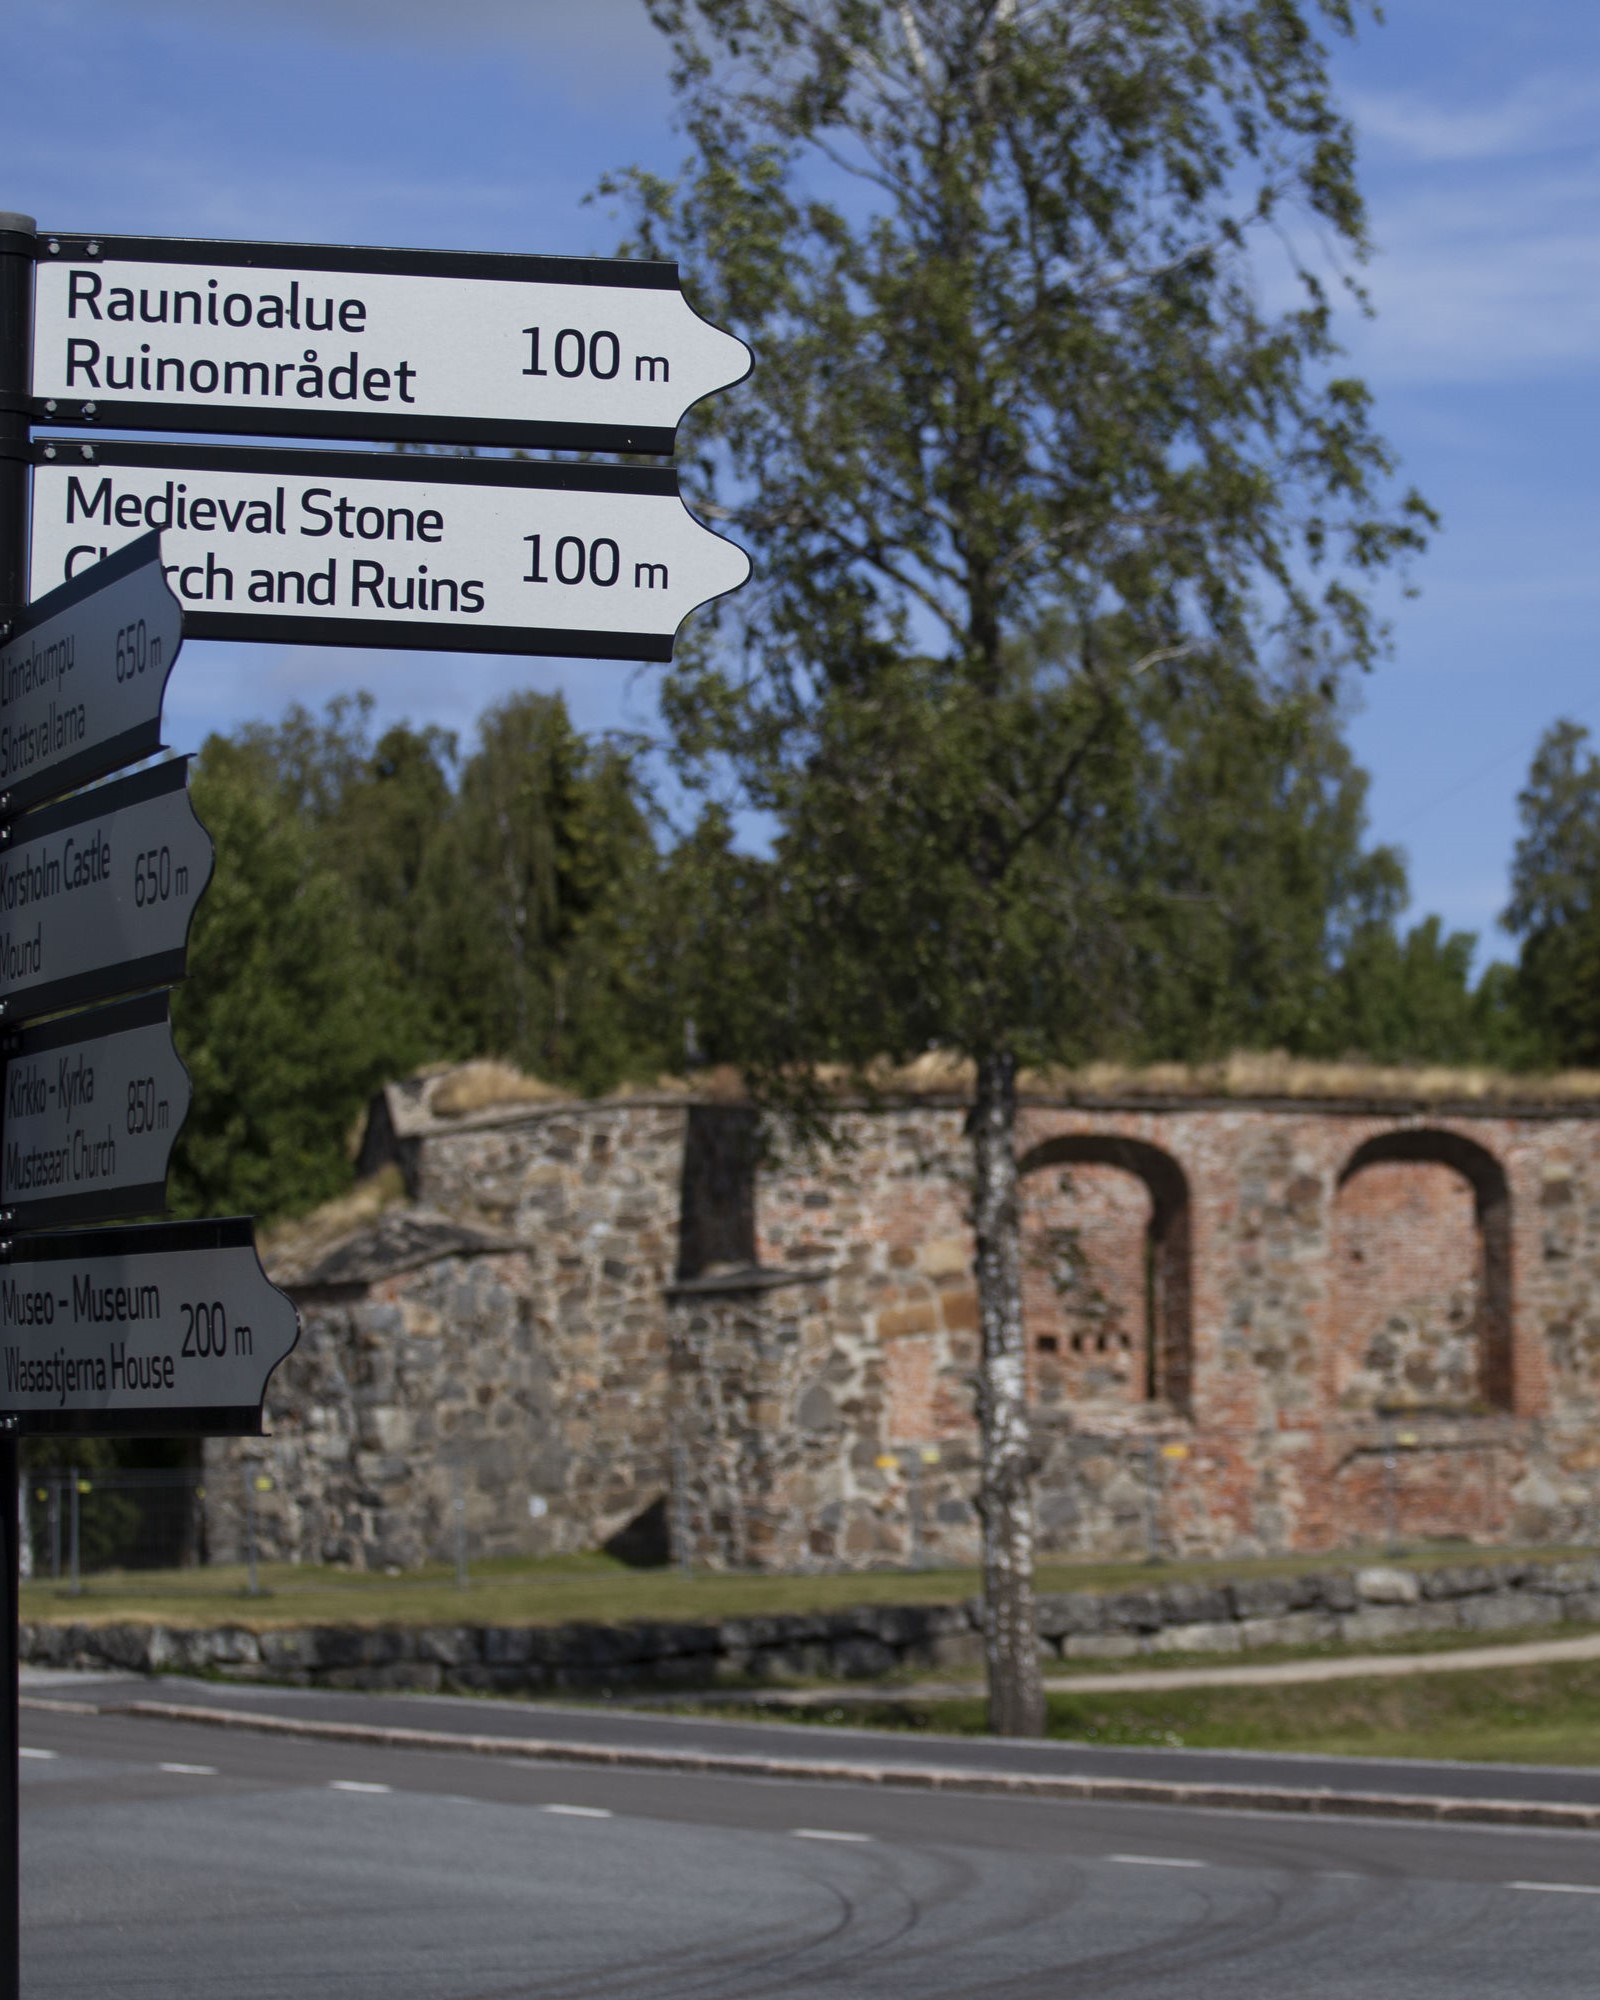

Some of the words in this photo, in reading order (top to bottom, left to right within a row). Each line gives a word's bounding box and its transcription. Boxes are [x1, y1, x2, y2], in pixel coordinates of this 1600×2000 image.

[67, 270, 367, 332] Raunioalue
[65, 338, 416, 403] Ruinområdet
[521, 326, 621, 380] 100
[635, 354, 670, 382] m
[65, 476, 286, 535] Medieval
[300, 487, 444, 544] Stone
[64, 545, 233, 601] Crch
[248, 559, 337, 606] and
[351, 560, 486, 614] Ruins
[522, 534, 620, 586] 100
[635, 563, 669, 589] m
[2, 635, 75, 706] Linnakumpu
[116, 618, 147, 684] 650
[150, 636, 162, 668] m
[0, 702, 86, 778] Slottsvallarna
[63, 829, 110, 890] Castle
[135, 846, 170, 908] 650
[175, 865, 188, 896] m
[8, 1064, 46, 1119] Kirkko
[58, 1053, 94, 1124] Kyrka
[127, 1076, 155, 1135] 850
[158, 1100, 169, 1129] m
[6, 1134, 70, 1191] Mustasaari
[72, 1124, 115, 1181] Church
[3, 1279, 54, 1326] Museo
[72, 1274, 160, 1323] Museum
[180, 1301, 226, 1358] 200
[234, 1325, 252, 1356] m
[5, 1346, 106, 1407] Wasastjerna
[110, 1342, 174, 1390] House
